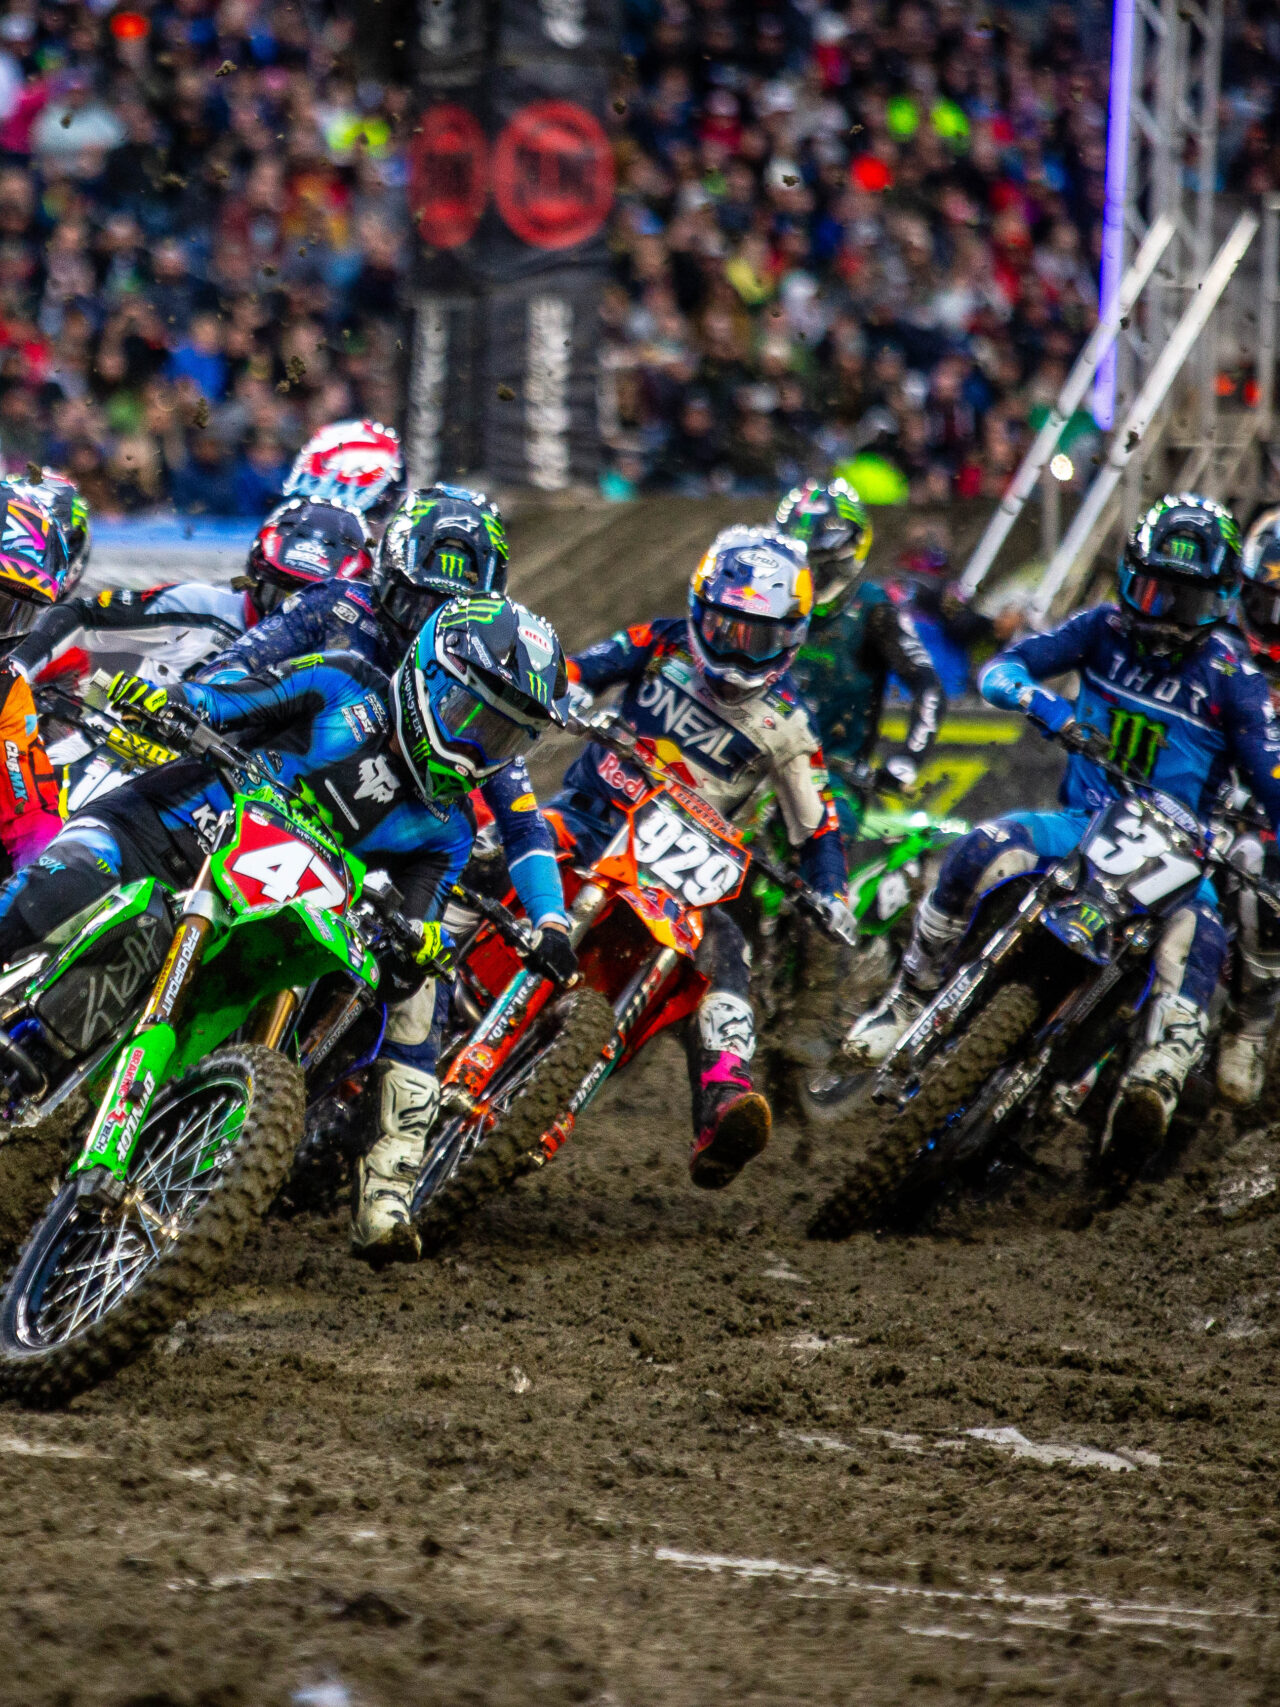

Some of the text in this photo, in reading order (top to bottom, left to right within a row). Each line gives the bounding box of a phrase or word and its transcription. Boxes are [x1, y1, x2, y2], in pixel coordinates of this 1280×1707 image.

[423, 576, 472, 592] MONSTE
[524, 629, 549, 650] BELL
[403, 669, 424, 738] MONSTER
[597, 752, 646, 802] Red
[232, 840, 347, 910] 47
[632, 809, 740, 908] 929
[162, 926, 201, 1017] PRO CIRCUIT
[118, 1047, 145, 1098] BRAKING
[116, 1069, 156, 1163] DUNLOP
